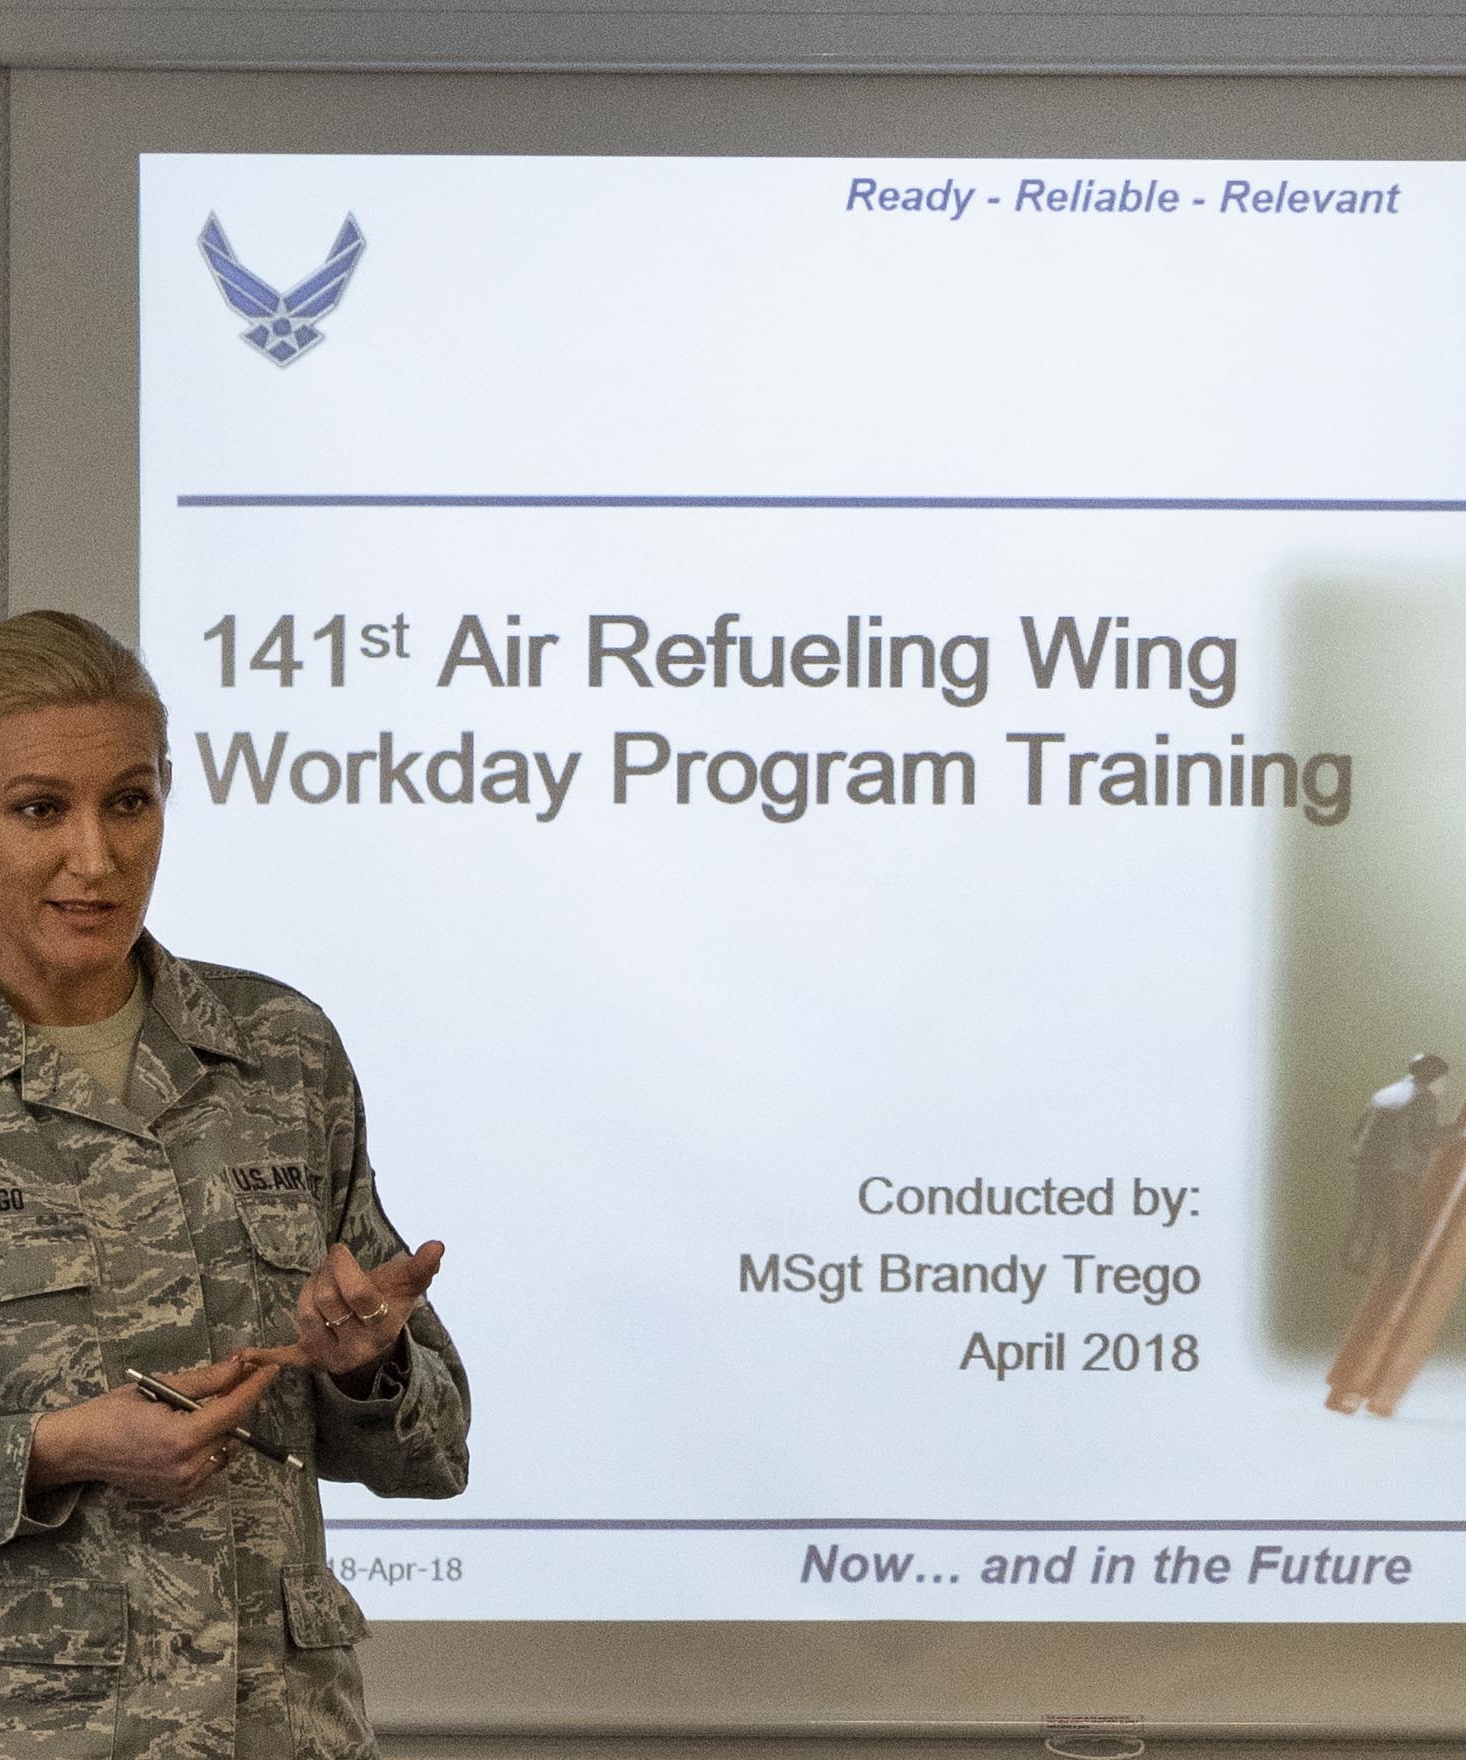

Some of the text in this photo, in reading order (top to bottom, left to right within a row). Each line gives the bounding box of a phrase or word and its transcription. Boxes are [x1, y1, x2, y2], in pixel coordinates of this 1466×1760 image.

[845, 177, 976, 221] Ready
[1015, 179, 1180, 213] Reliable
[1219, 180, 1402, 215] Relevant
[202, 611, 1239, 711] 141st Air Refueling Wing
[194, 729, 1354, 828] Workday Program Training
[858, 1176, 1201, 1228] Conducted by:
[739, 1252, 1203, 1305] MSgt Brandy Trego
[959, 1331, 1201, 1381] April 2018
[980, 1545, 1078, 1585] and
[1090, 1545, 1136, 1585] in
[1153, 1545, 1233, 1585] the
[1247, 1545, 1413, 1585] Future
